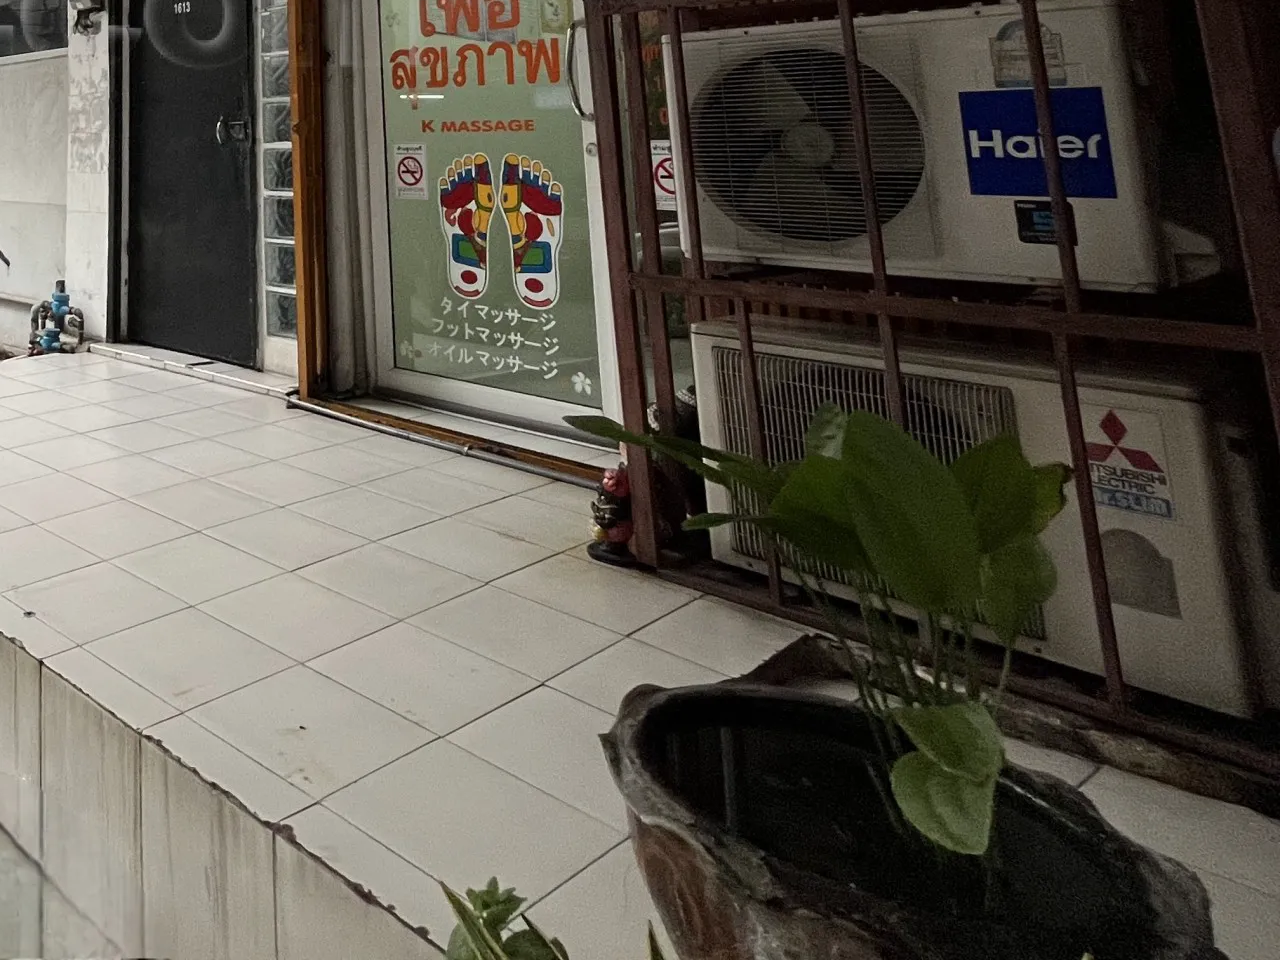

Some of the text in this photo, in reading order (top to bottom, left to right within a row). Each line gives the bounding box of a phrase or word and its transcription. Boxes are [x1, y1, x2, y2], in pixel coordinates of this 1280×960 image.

[174, 1, 191, 15] 1613
[389, 37, 561, 111] สุขภาพ
[421, 119, 536, 133] K MASSAGE
[440, 296, 557, 331] タイマッサージ
[431, 318, 560, 356] フットマッサージ
[428, 342, 558, 380] オイルマッサージ
[1089, 462, 1167, 486] ITSUBISHI
